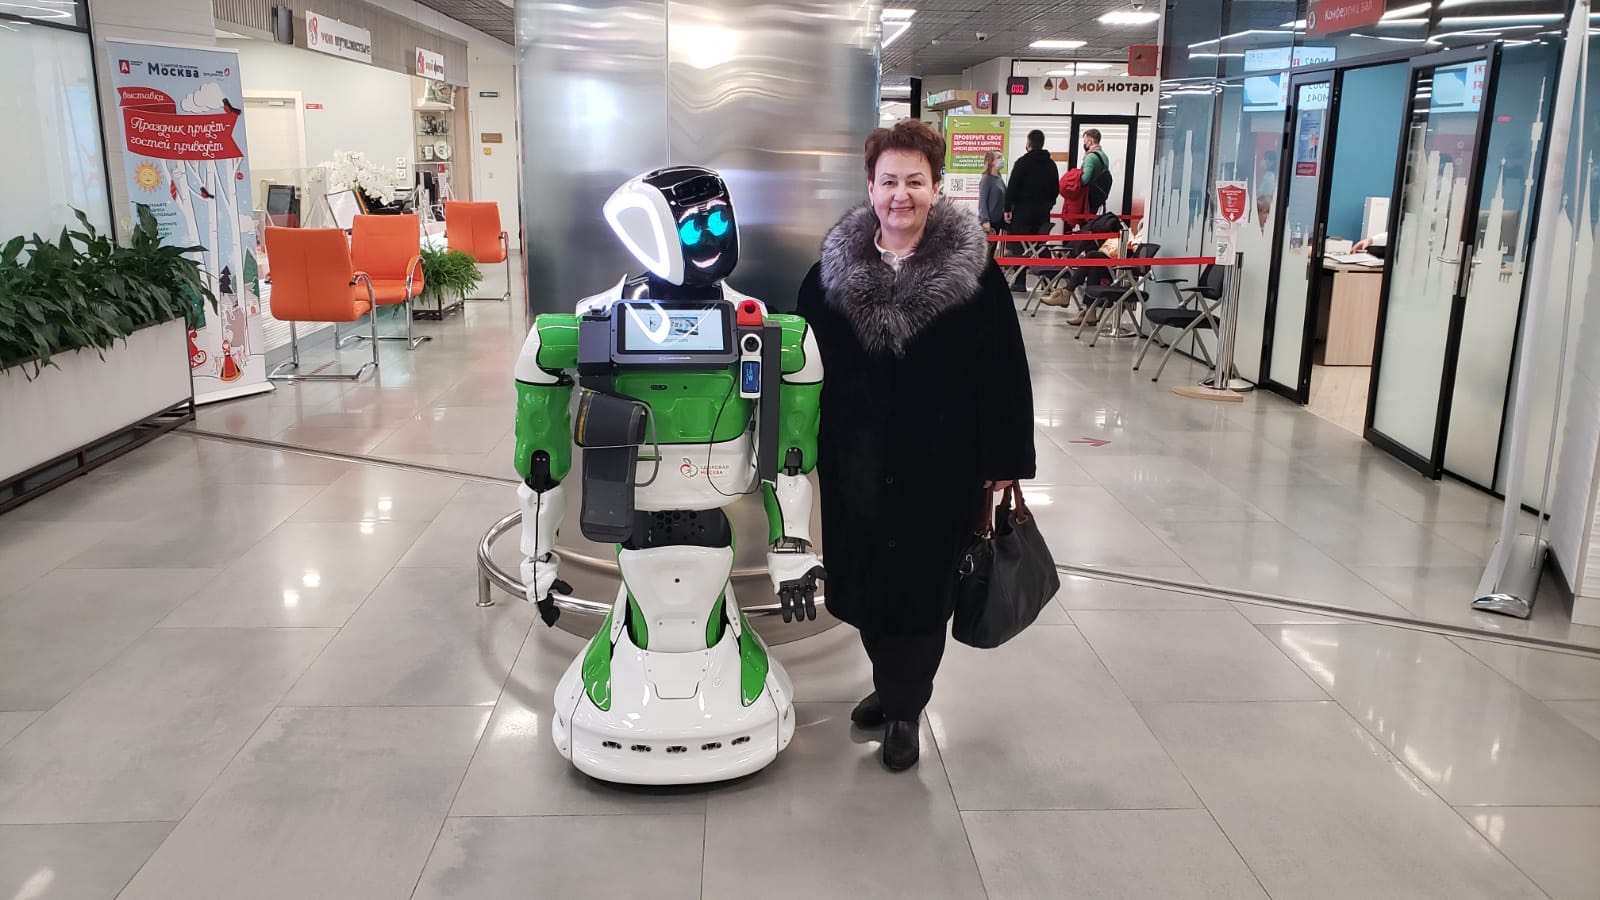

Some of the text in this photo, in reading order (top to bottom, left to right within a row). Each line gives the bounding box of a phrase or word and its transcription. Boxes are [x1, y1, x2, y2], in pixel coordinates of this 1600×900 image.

[147, 62, 200, 78] Москва
[1076, 79, 1105, 92] мой
[122, 91, 164, 102] выставка
[130, 116, 187, 139] Праздник
[130, 136, 224, 158] гостей приведёт
